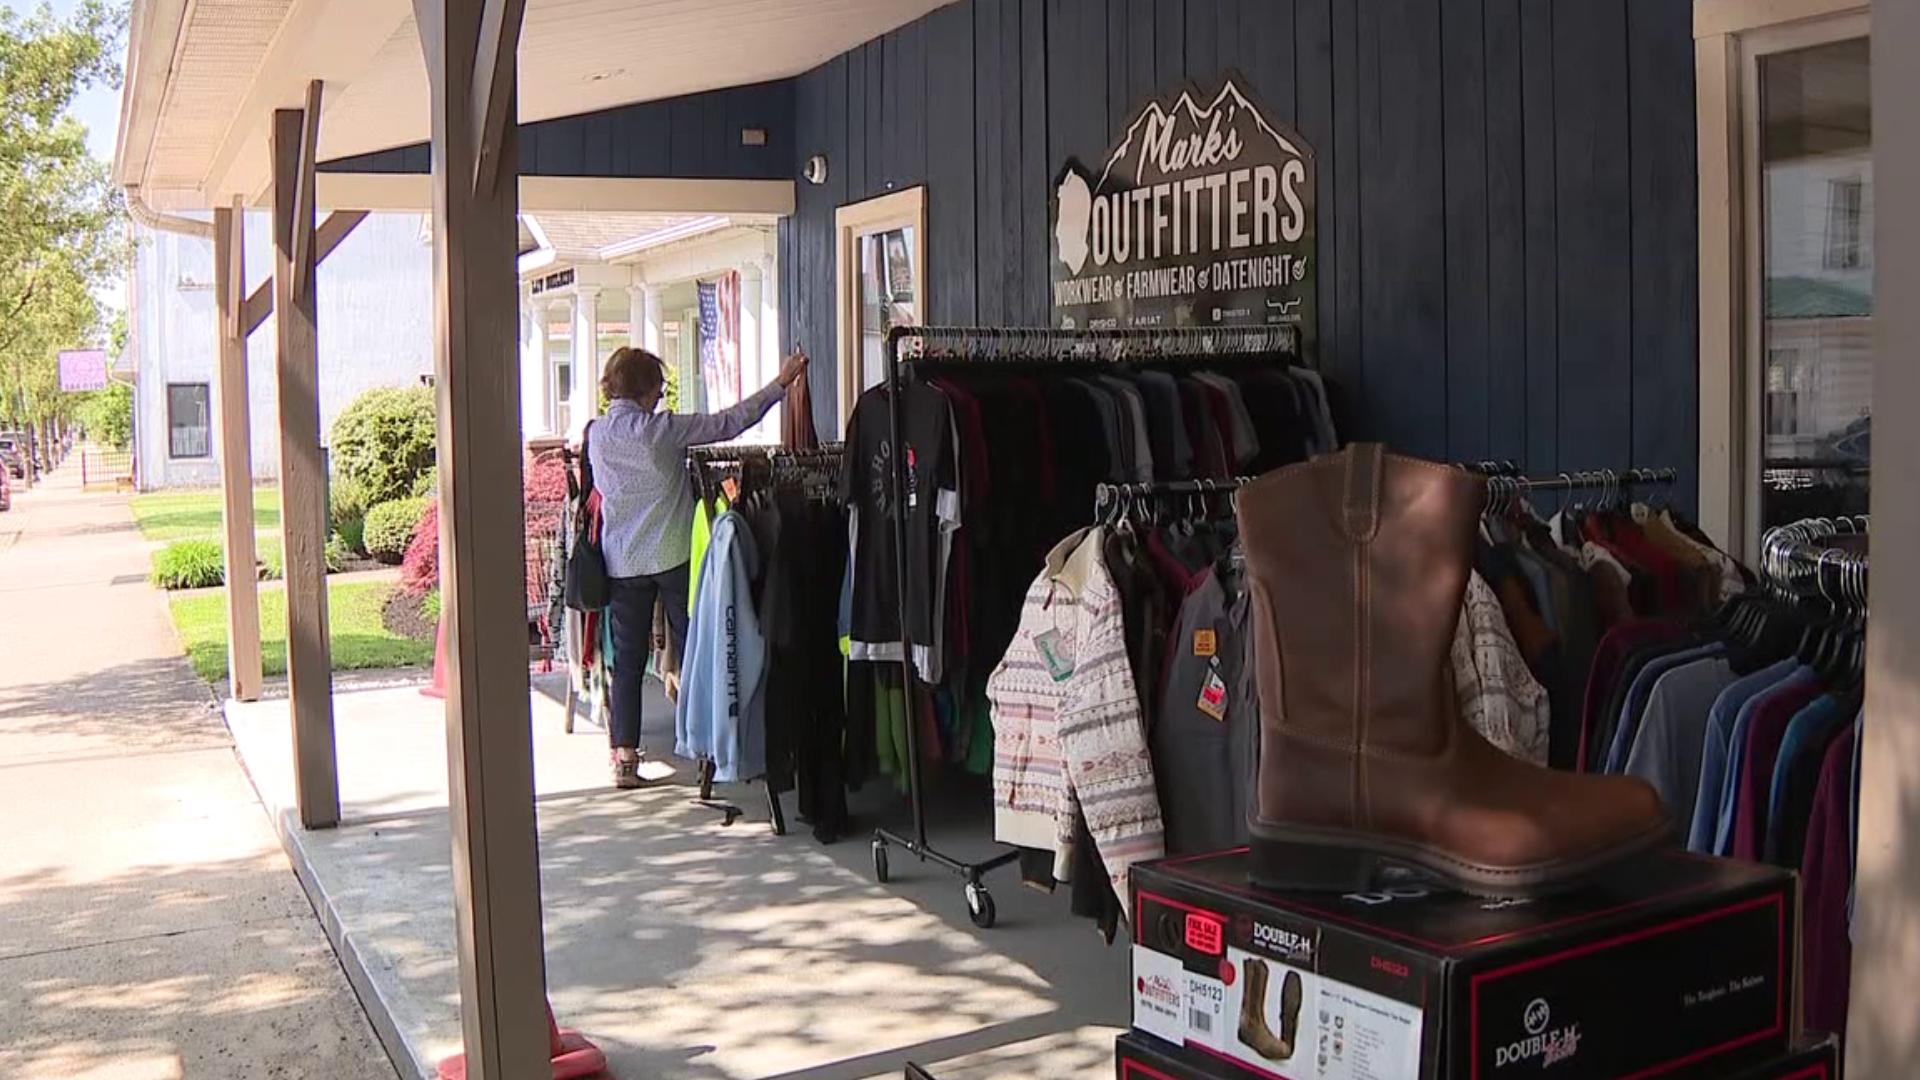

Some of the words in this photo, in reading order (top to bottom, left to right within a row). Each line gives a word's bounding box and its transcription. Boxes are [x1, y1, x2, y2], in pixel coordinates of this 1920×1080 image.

[1137, 104, 1243, 186] Mark's
[1092, 158, 1306, 266] OUTFITTERS
[1055, 275, 1113, 307] WORKWEAR
[1127, 265, 1196, 299] FARMWEAR
[1212, 254, 1292, 292] DATENIGHT
[1135, 316, 1162, 326] ARIAT
[1253, 921, 1311, 953] DOUBLE-H
[1189, 980, 1223, 1002] DH5123
[1496, 1024, 1577, 1068] DOUBLE-H
